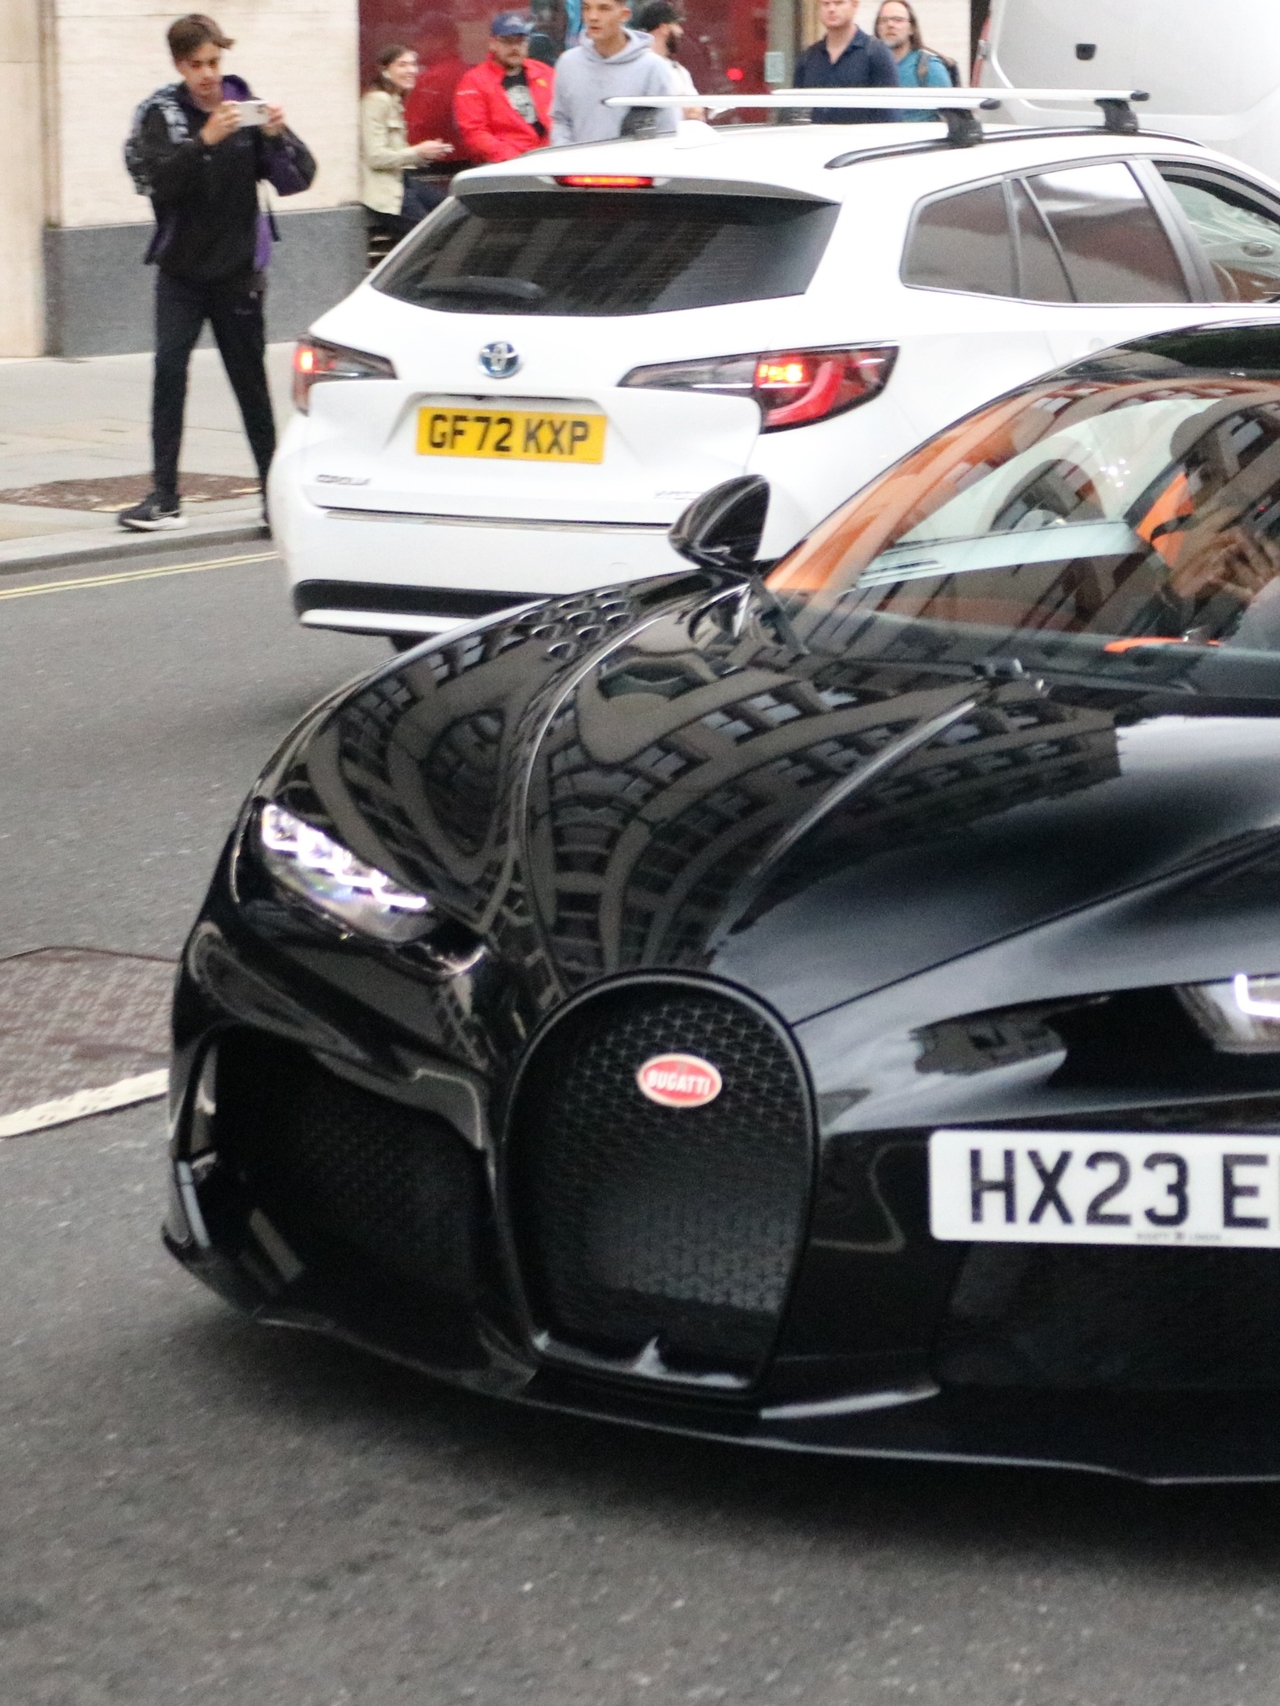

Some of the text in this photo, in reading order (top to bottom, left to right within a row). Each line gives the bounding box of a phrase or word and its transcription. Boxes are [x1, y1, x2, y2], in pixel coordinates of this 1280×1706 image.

[428, 414, 590, 456] GF72 KXP
[647, 1069, 711, 1095] BUGATTI
[969, 1149, 1189, 1226] HX23
